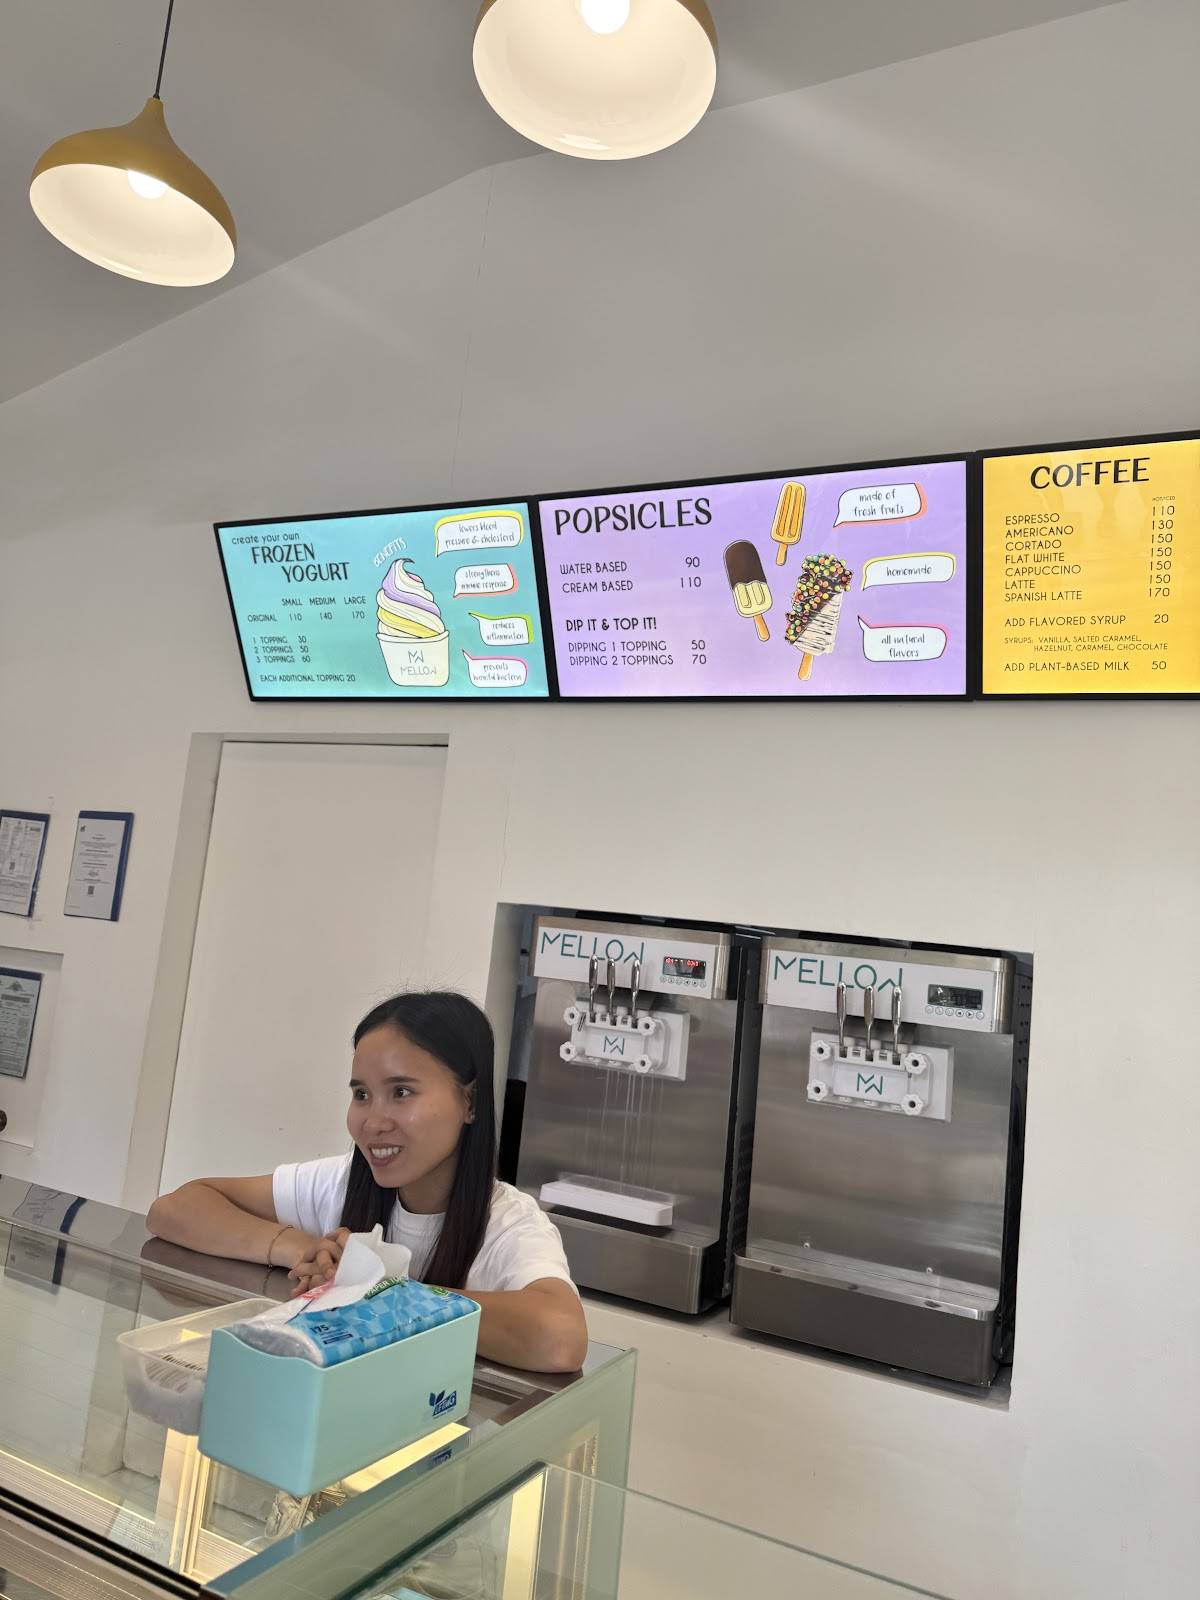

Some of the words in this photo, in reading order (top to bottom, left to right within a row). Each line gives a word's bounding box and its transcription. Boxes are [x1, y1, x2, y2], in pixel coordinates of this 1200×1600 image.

[1030, 458, 1150, 489] COFFEE
[860, 490, 882, 502] made
[886, 489, 896, 499] of
[554, 498, 712, 535] POPSICLES
[854, 506, 876, 518] fresh
[881, 504, 904, 514] fruits
[1005, 513, 1060, 525] ESPRESSO
[1153, 506, 1174, 516] 110
[1006, 525, 1073, 538] AMERICANO
[1152, 520, 1173, 530] 130
[232, 535, 258, 544] create
[262, 534, 280, 544] your
[1005, 539, 1062, 551] CORTADO
[1152, 534, 1172, 544] 150
[252, 543, 315, 564] FROZEN
[1005, 553, 1029, 564] FLAT
[1034, 552, 1064, 562] WHITE
[1151, 547, 1172, 557] 150
[281, 562, 349, 582] YOGURT
[560, 563, 592, 574] WATER
[596, 561, 627, 573] BASED
[685, 556, 700, 568] 90
[886, 566, 932, 576] homemade
[1005, 565, 1081, 577] CAPPUCCINO
[1150, 561, 1171, 571] 150
[562, 582, 598, 593] CREAM
[602, 580, 633, 591] BASED
[680, 577, 701, 588] 110
[1005, 580, 1035, 590] LATTE
[1150, 574, 1170, 584] 150
[344, 596, 366, 604] LARGE
[1005, 592, 1046, 602] SPANISH
[1051, 591, 1082, 601] LATTE
[1149, 588, 1170, 597] 170
[248, 614, 278, 622] ORIGINAL
[289, 613, 302, 621] 110
[320, 612, 332, 620] 140
[352, 611, 365, 619] 170
[1005, 617, 1025, 627] ADD
[1030, 617, 1085, 626] FLAVORED
[1090, 615, 1126, 625] SYRUP
[1154, 614, 1169, 624] 20
[566, 619, 583, 631] DIP
[587, 619, 597, 630] IT
[601, 619, 609, 630] &
[613, 618, 638, 630] TOP
[643, 617, 657, 629] IT!
[568, 642, 606, 652] DIPPING
[612, 641, 616, 651] 1
[621, 640, 667, 651] TOPPING
[691, 640, 705, 650] 50
[882, 635, 891, 644] all
[894, 634, 925, 644] natural
[1038, 636, 1070, 644] VANILLA,
[254, 646, 258, 654] 2
[889, 648, 919, 658] flavors
[1076, 644, 1114, 652] CARAMEL,
[570, 656, 608, 666] DIPPING
[612, 655, 618, 665] 2
[622, 654, 673, 665] TOPPINGS
[692, 654, 706, 665] 70
[1005, 663, 1024, 672] ADD
[1029, 662, 1099, 671] PLANT-BASED
[1104, 662, 1129, 670] MILK
[1152, 661, 1167, 670] 50
[400, 666, 437, 675] MELLOW
[541, 932, 644, 965] MELLOW
[774, 956, 902, 992] MELLOW
